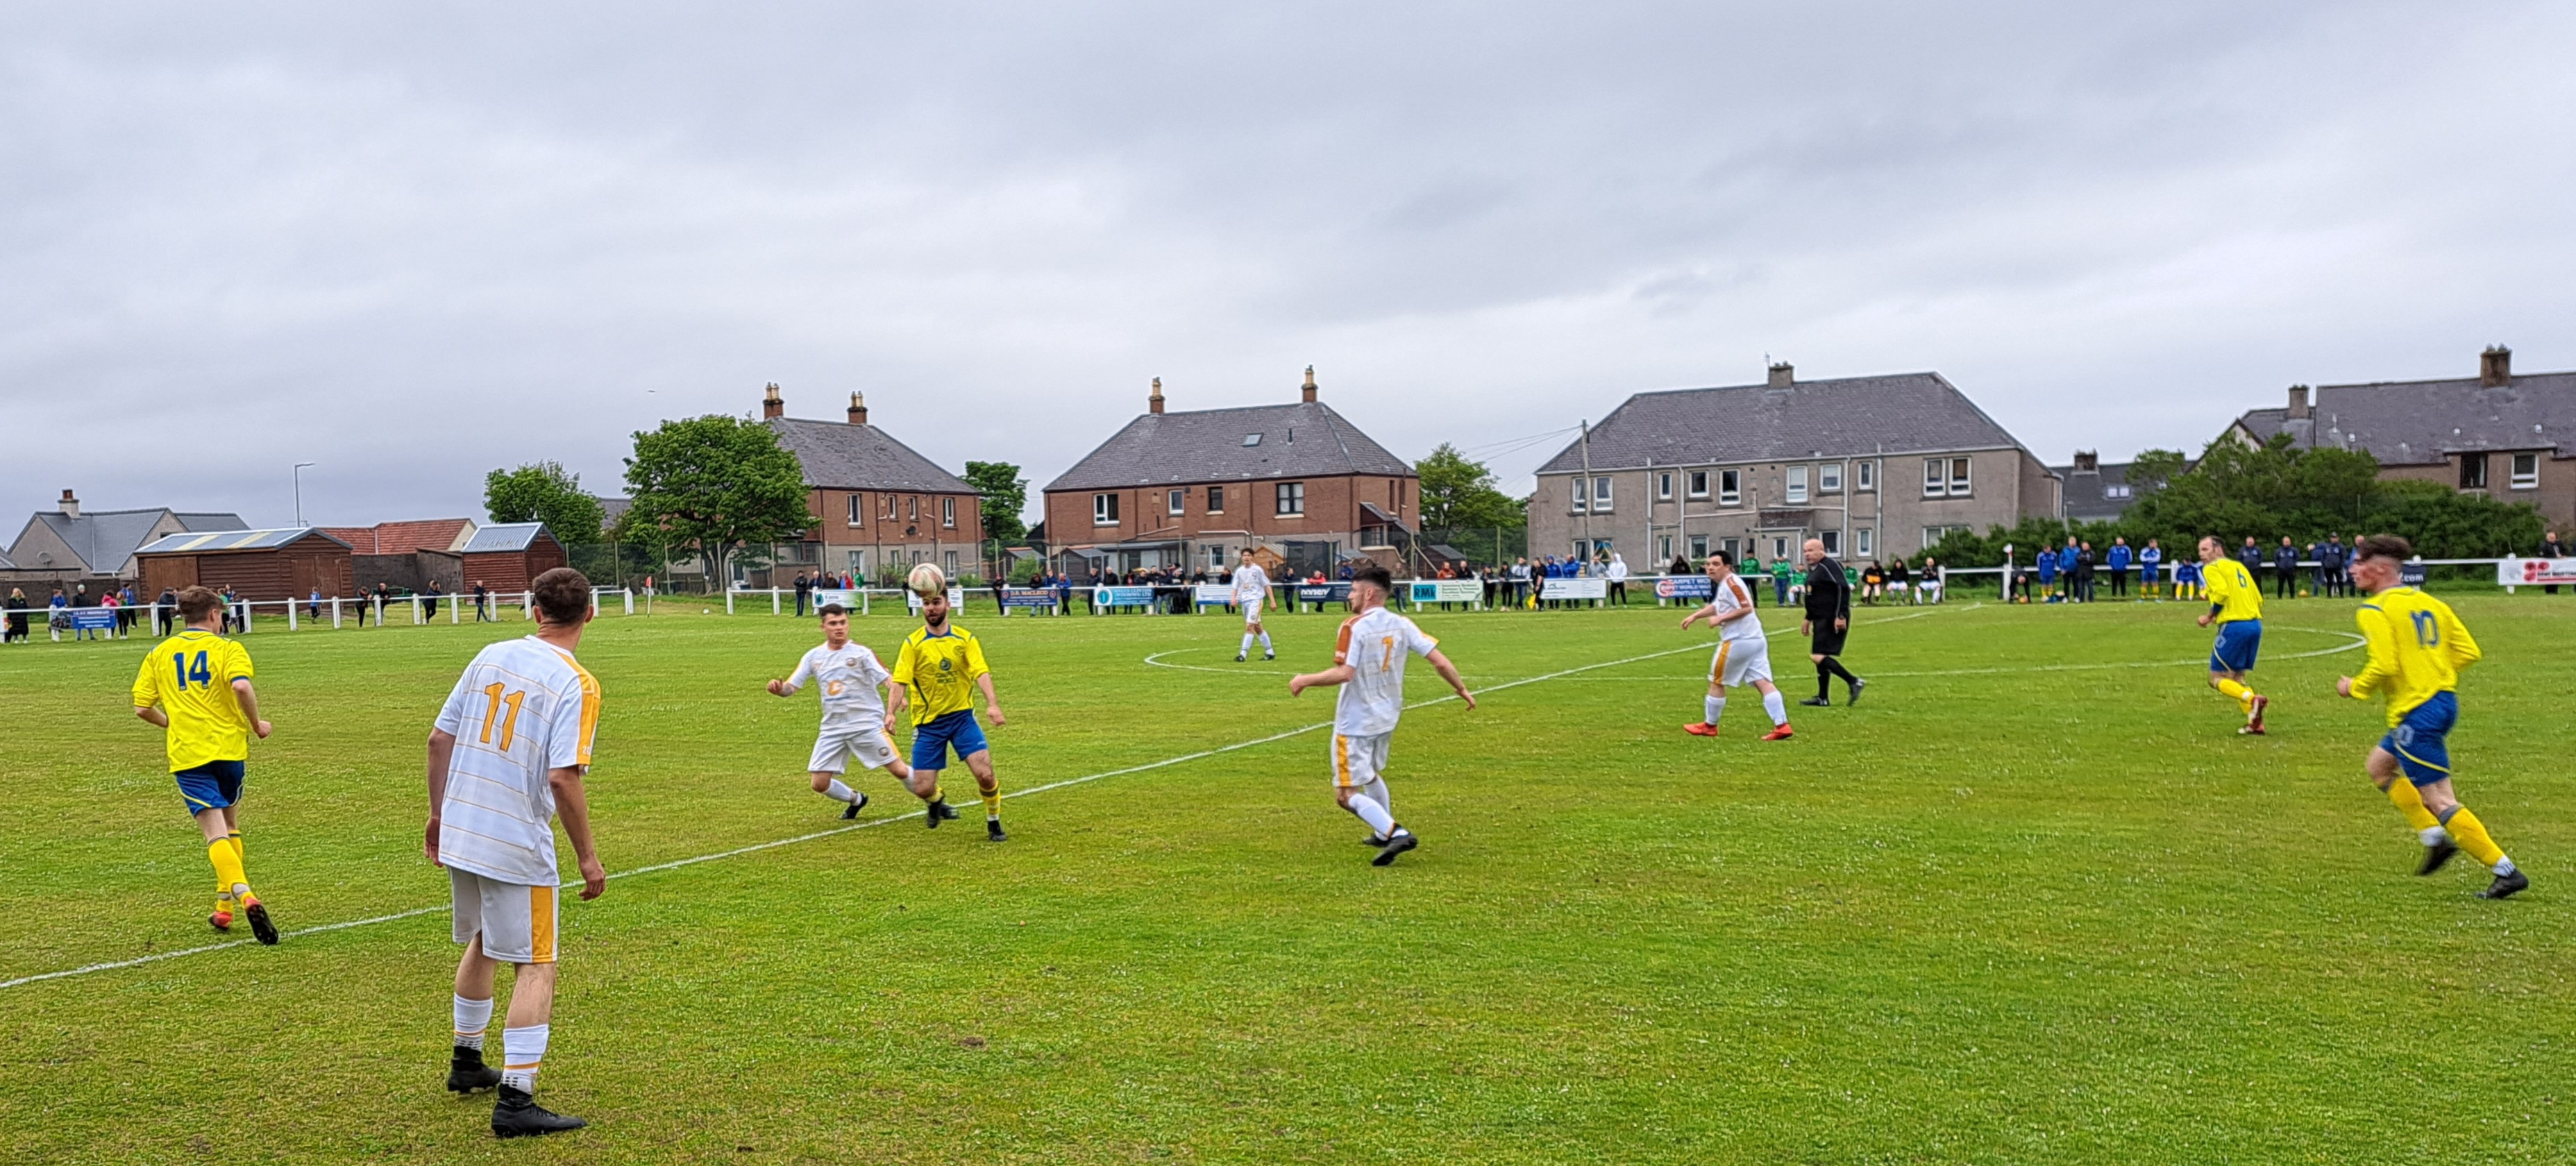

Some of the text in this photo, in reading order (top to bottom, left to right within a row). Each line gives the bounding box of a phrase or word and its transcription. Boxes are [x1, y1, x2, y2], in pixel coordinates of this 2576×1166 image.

[2236, 567, 2248, 589] 6
[2410, 610, 2439, 648] 10
[173, 650, 212, 691] 14
[479, 682, 525, 752] 11
